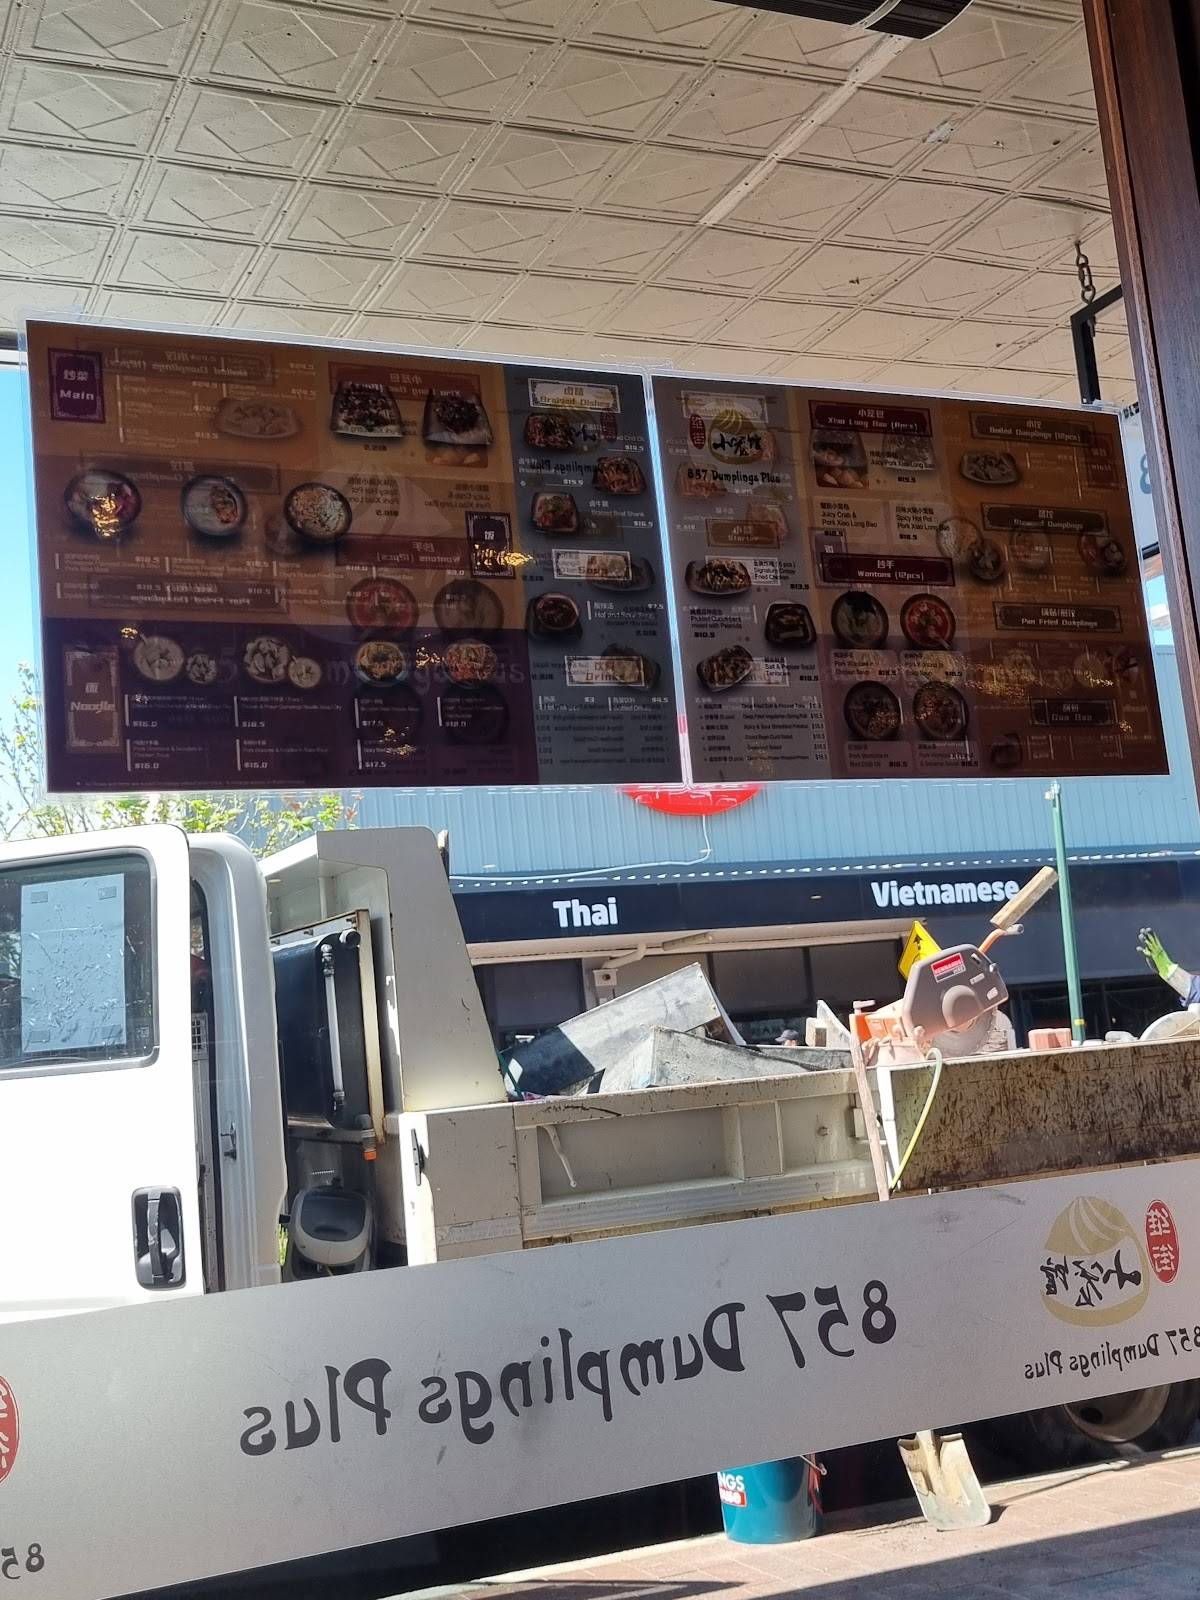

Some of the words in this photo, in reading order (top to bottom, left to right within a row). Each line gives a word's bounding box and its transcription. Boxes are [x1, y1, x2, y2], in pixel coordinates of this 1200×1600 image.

[59, 389, 94, 402] Main
[711, 468, 759, 485] Dumplings
[857, 569, 892, 579] Wontons
[871, 879, 1020, 909] Vietnamese
[553, 896, 619, 929] Thai
